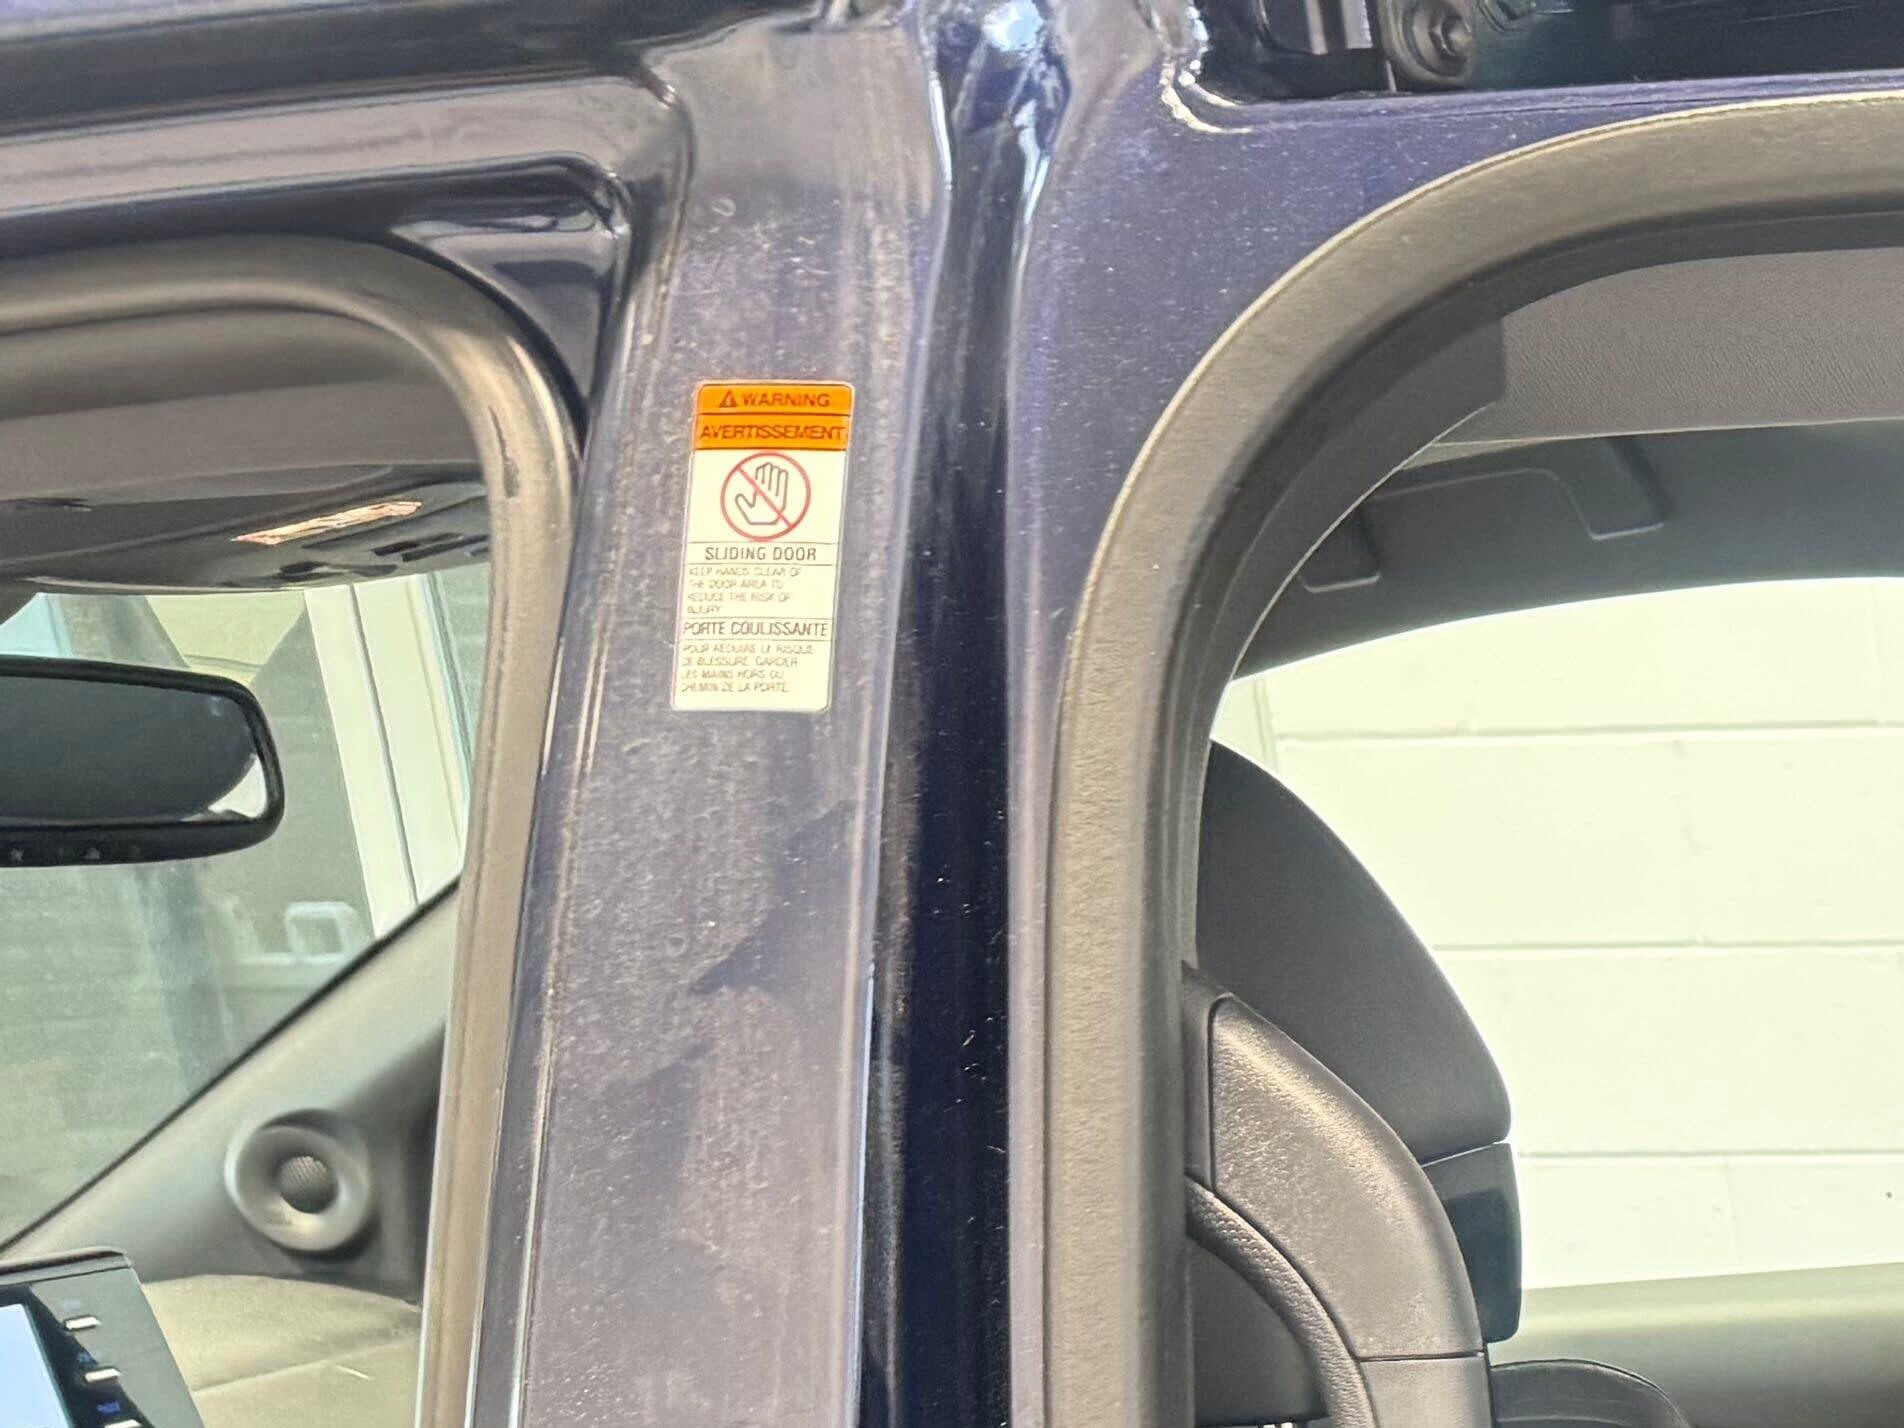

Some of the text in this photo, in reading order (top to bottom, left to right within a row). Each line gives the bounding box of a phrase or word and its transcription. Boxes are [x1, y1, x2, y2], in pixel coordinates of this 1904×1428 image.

[742, 393, 831, 408] WARNING
[700, 424, 846, 440] AVERTISSEMENT
[704, 546, 817, 561] SLIDING DOOR
[682, 621, 830, 637] PORTE COULISSANTE
